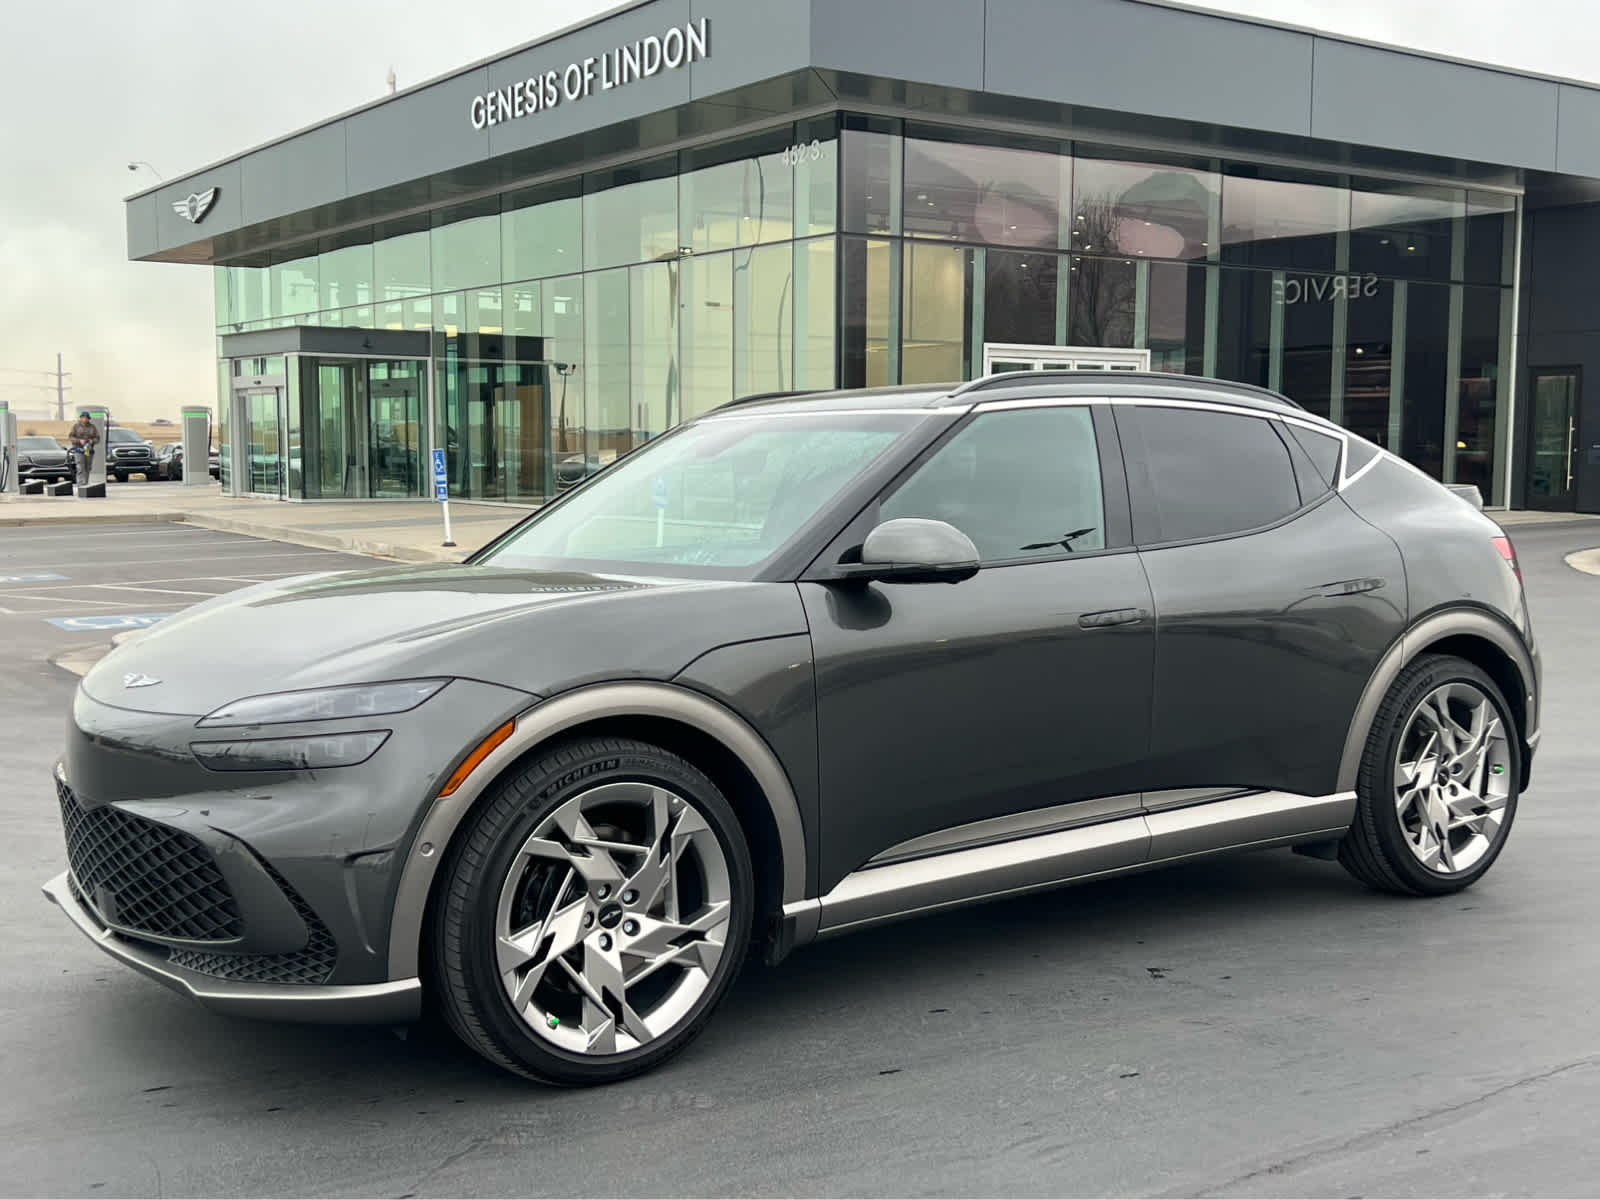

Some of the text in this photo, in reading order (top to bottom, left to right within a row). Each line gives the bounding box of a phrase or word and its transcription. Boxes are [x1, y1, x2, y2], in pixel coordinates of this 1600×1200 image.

[471, 17, 707, 129] GENESIS OF LINDON
[546, 759, 618, 796] MICHELIN
